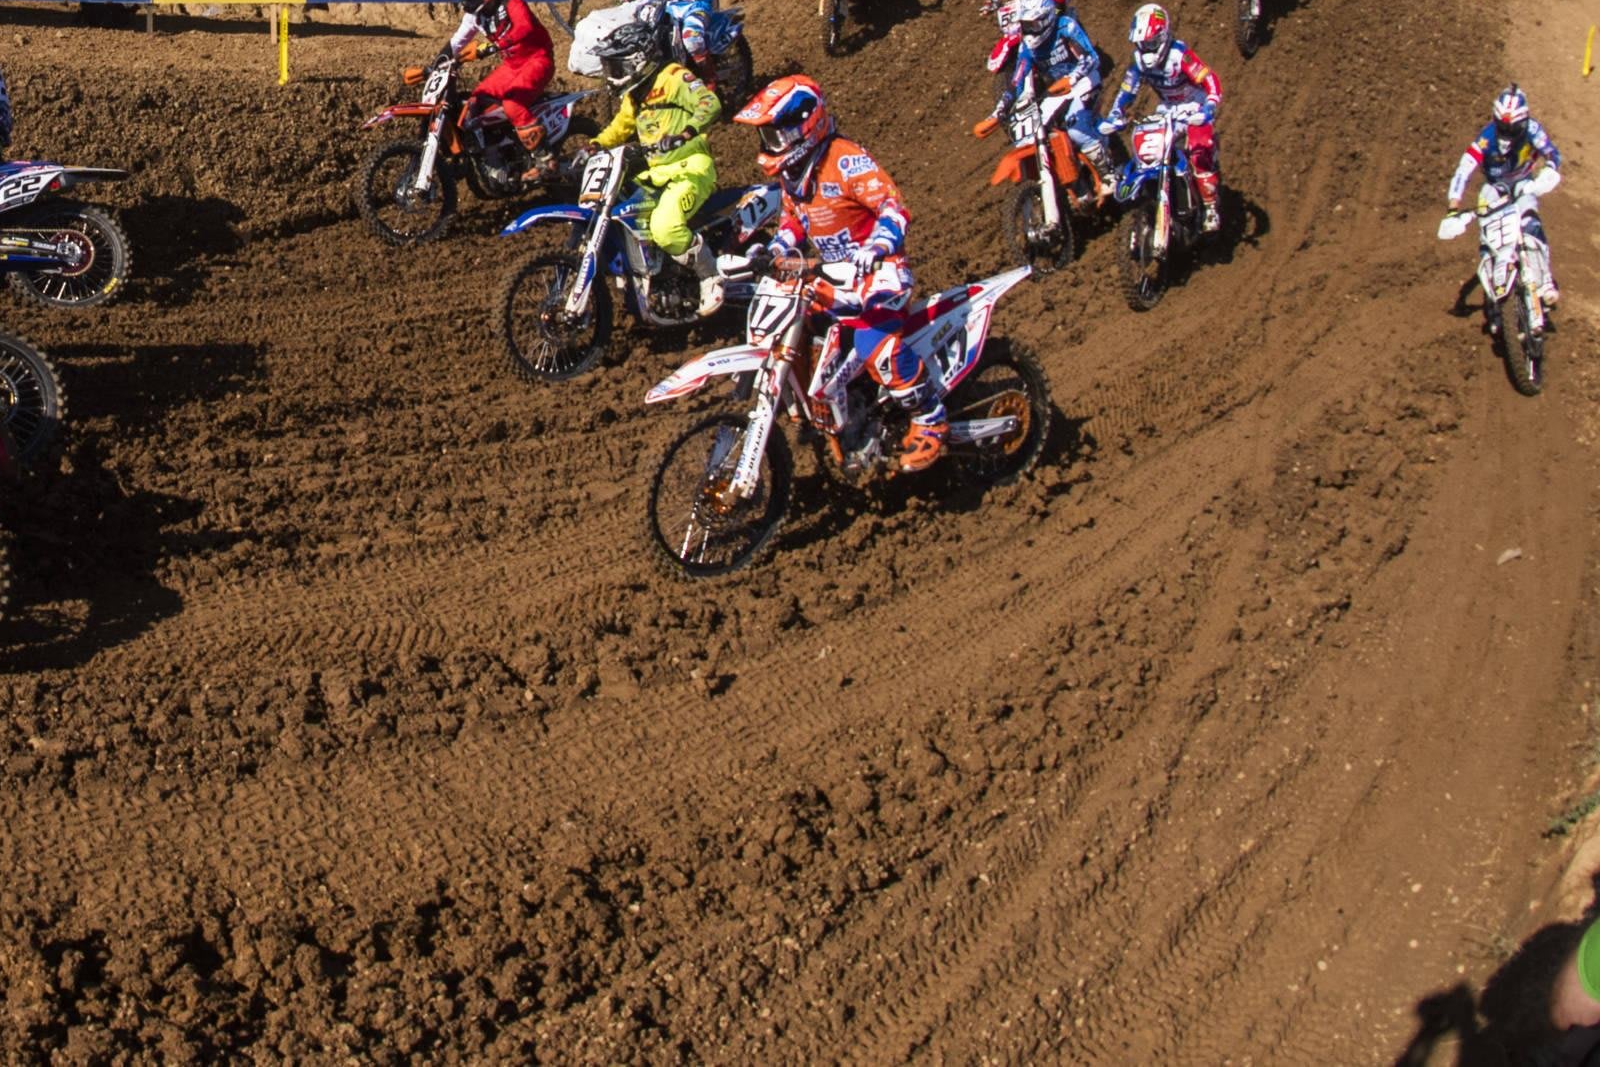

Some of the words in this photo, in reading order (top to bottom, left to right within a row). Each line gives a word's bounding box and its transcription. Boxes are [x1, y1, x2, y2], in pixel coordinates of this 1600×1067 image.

[1011, 120, 1034, 138] 11
[1138, 135, 1159, 162] 2
[3, 175, 41, 199] 22
[744, 197, 768, 225] 73
[816, 230, 849, 251] HSF
[750, 295, 793, 330] 17
